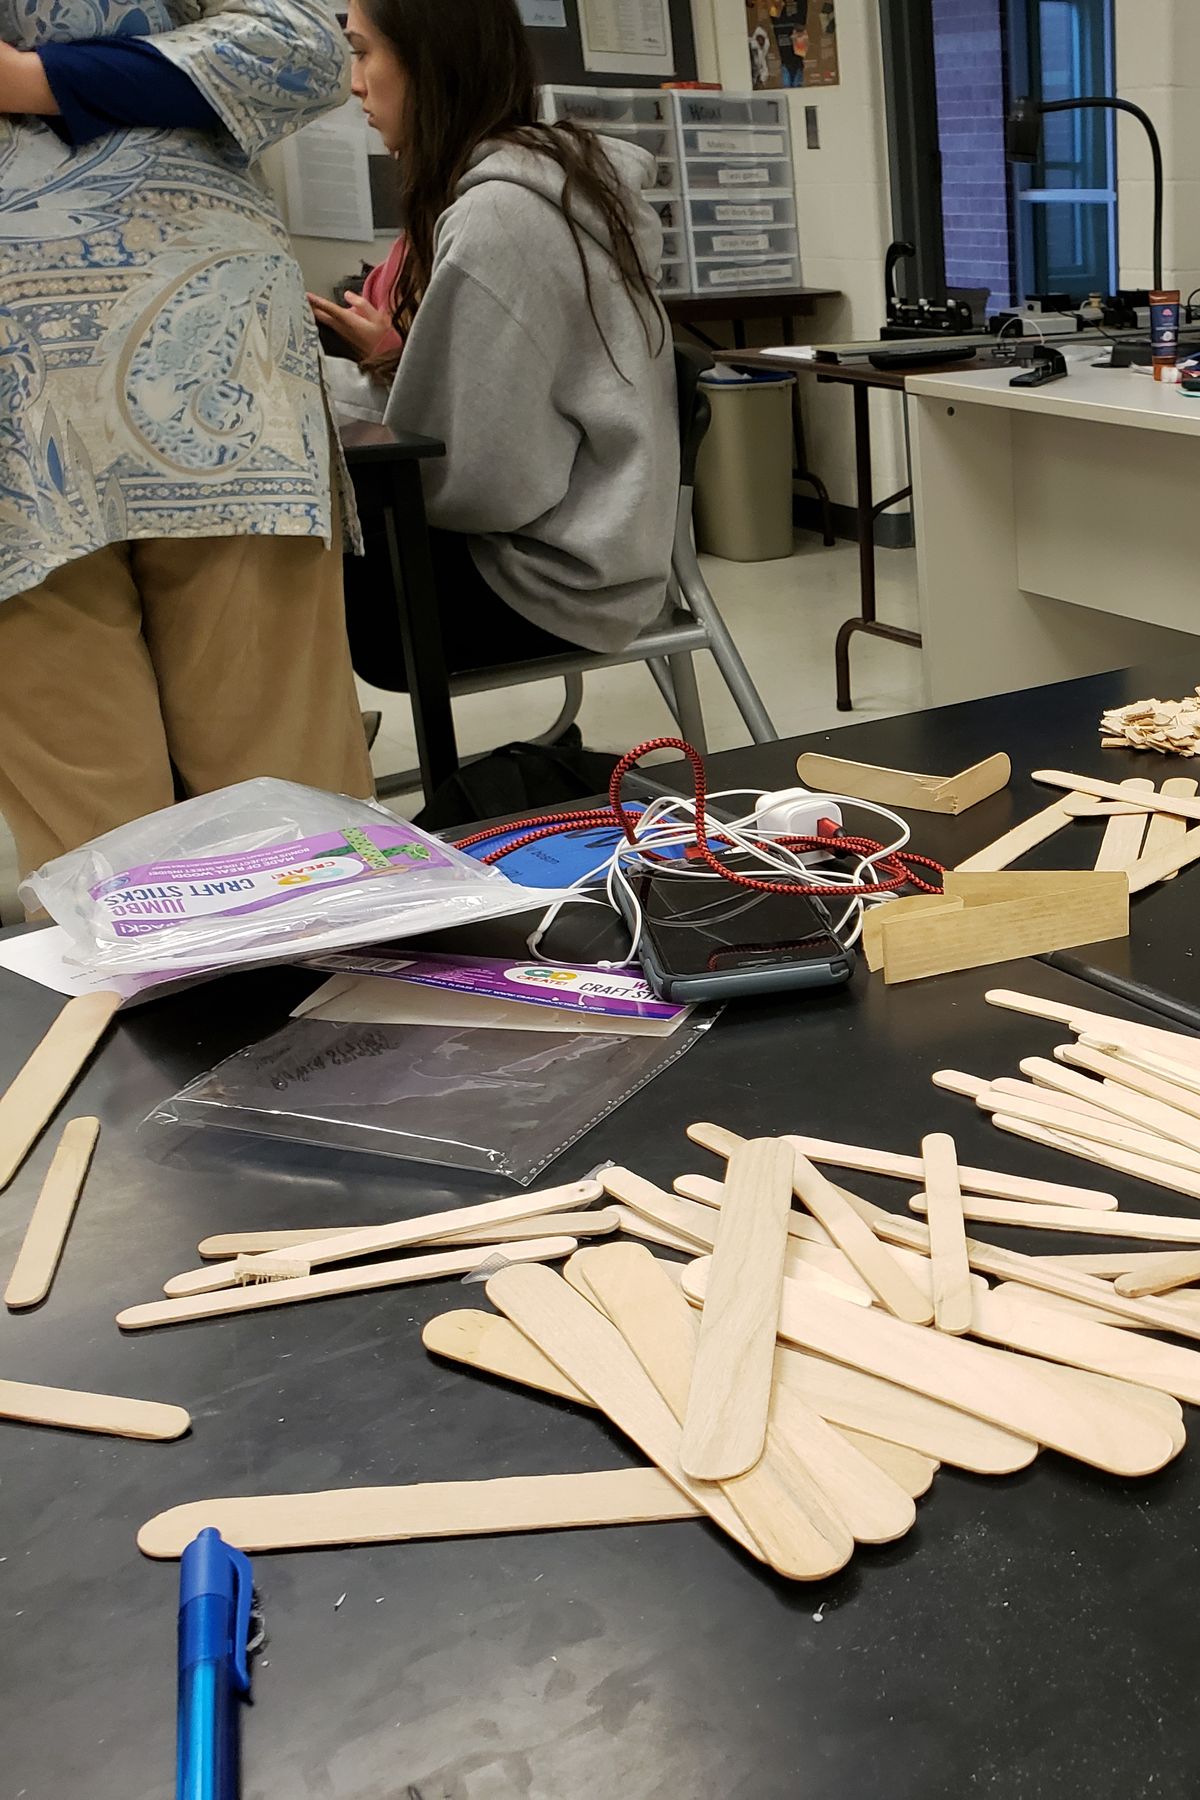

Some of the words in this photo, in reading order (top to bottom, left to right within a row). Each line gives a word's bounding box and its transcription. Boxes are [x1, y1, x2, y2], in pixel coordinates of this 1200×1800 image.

[270, 861, 336, 880] CREATE!
[103, 885, 184, 906] STICKS
[190, 878, 256, 897] CRAFT
[516, 974, 570, 986] CREATE!
[579, 982, 628, 997] CRAFT
